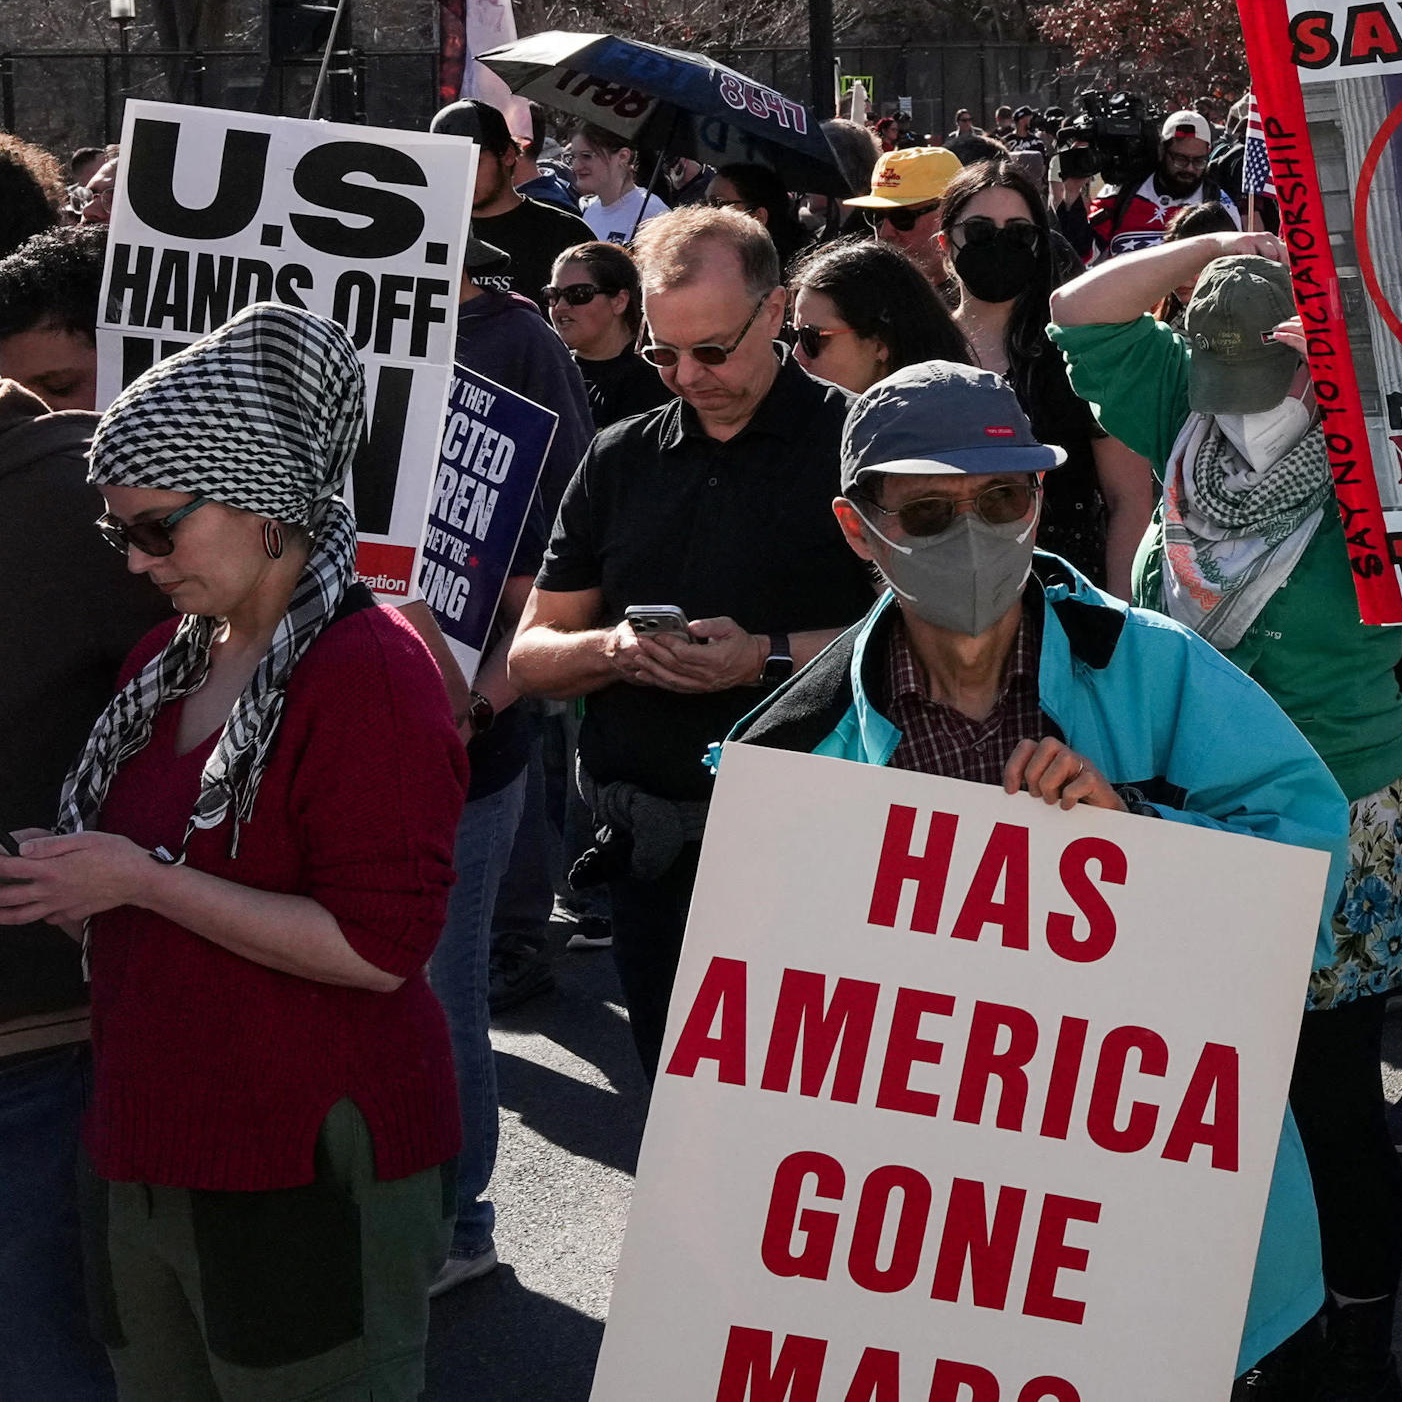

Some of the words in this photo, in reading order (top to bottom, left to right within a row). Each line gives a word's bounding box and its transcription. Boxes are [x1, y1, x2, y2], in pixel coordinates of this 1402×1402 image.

[719, 71, 808, 135] 8647
[126, 117, 447, 265] U.S.
[1265, 115, 1337, 356] DICTATORSHIP
[333, 269, 451, 358] OFF
[459, 381, 496, 418] THEY
[441, 406, 516, 485] CTED
[1325, 432, 1363, 496] NO
[1342, 501, 1384, 581] SAY
[867, 802, 1128, 964] HAS
[665, 955, 1240, 1173] AMERICA
[760, 1150, 1103, 1325] GONE
